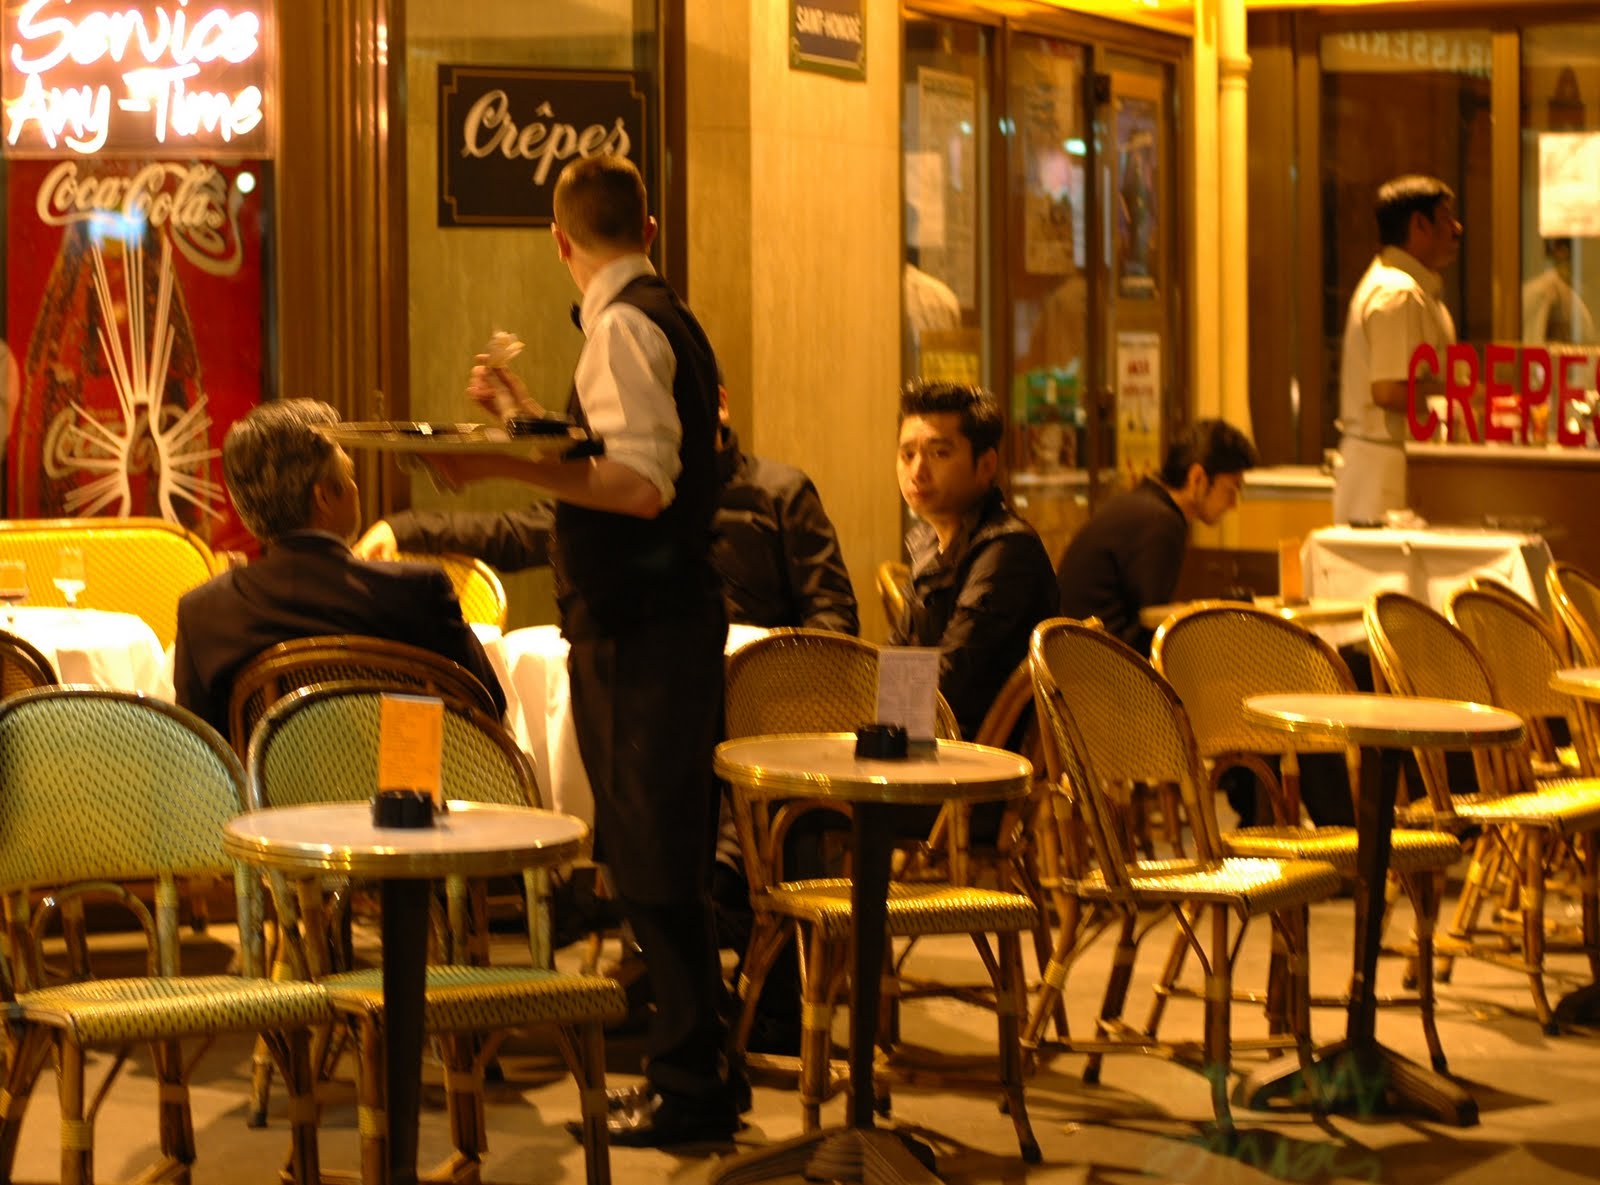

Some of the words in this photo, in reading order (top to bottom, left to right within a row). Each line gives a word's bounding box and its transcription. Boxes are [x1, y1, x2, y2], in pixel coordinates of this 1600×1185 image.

[11, 0, 260, 74] Service
[461, 89, 631, 186] Crêpes
[1407, 342, 1600, 447] CREPE
